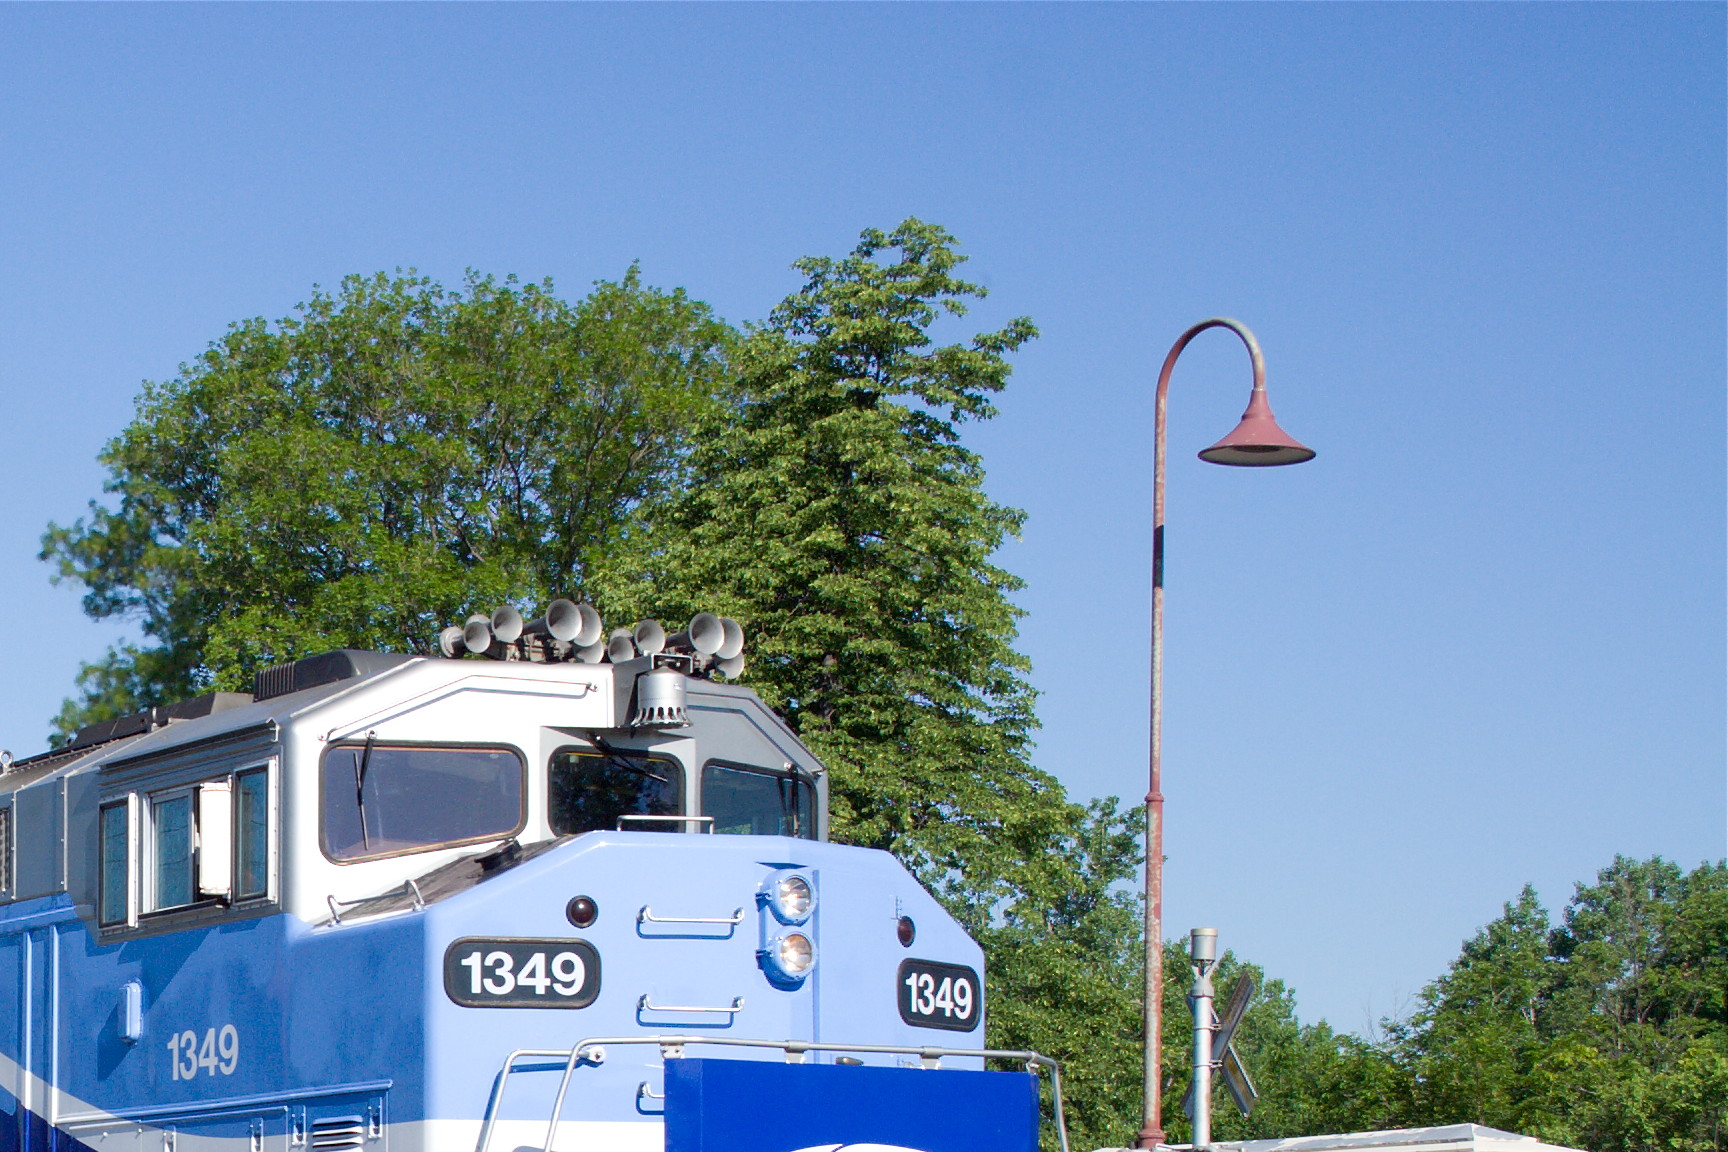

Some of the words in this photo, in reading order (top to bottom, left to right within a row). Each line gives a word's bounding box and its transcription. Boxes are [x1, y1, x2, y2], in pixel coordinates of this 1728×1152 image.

[461, 951, 586, 996] 1349
[905, 972, 973, 1020] 1349
[167, 1024, 239, 1081] 1349
